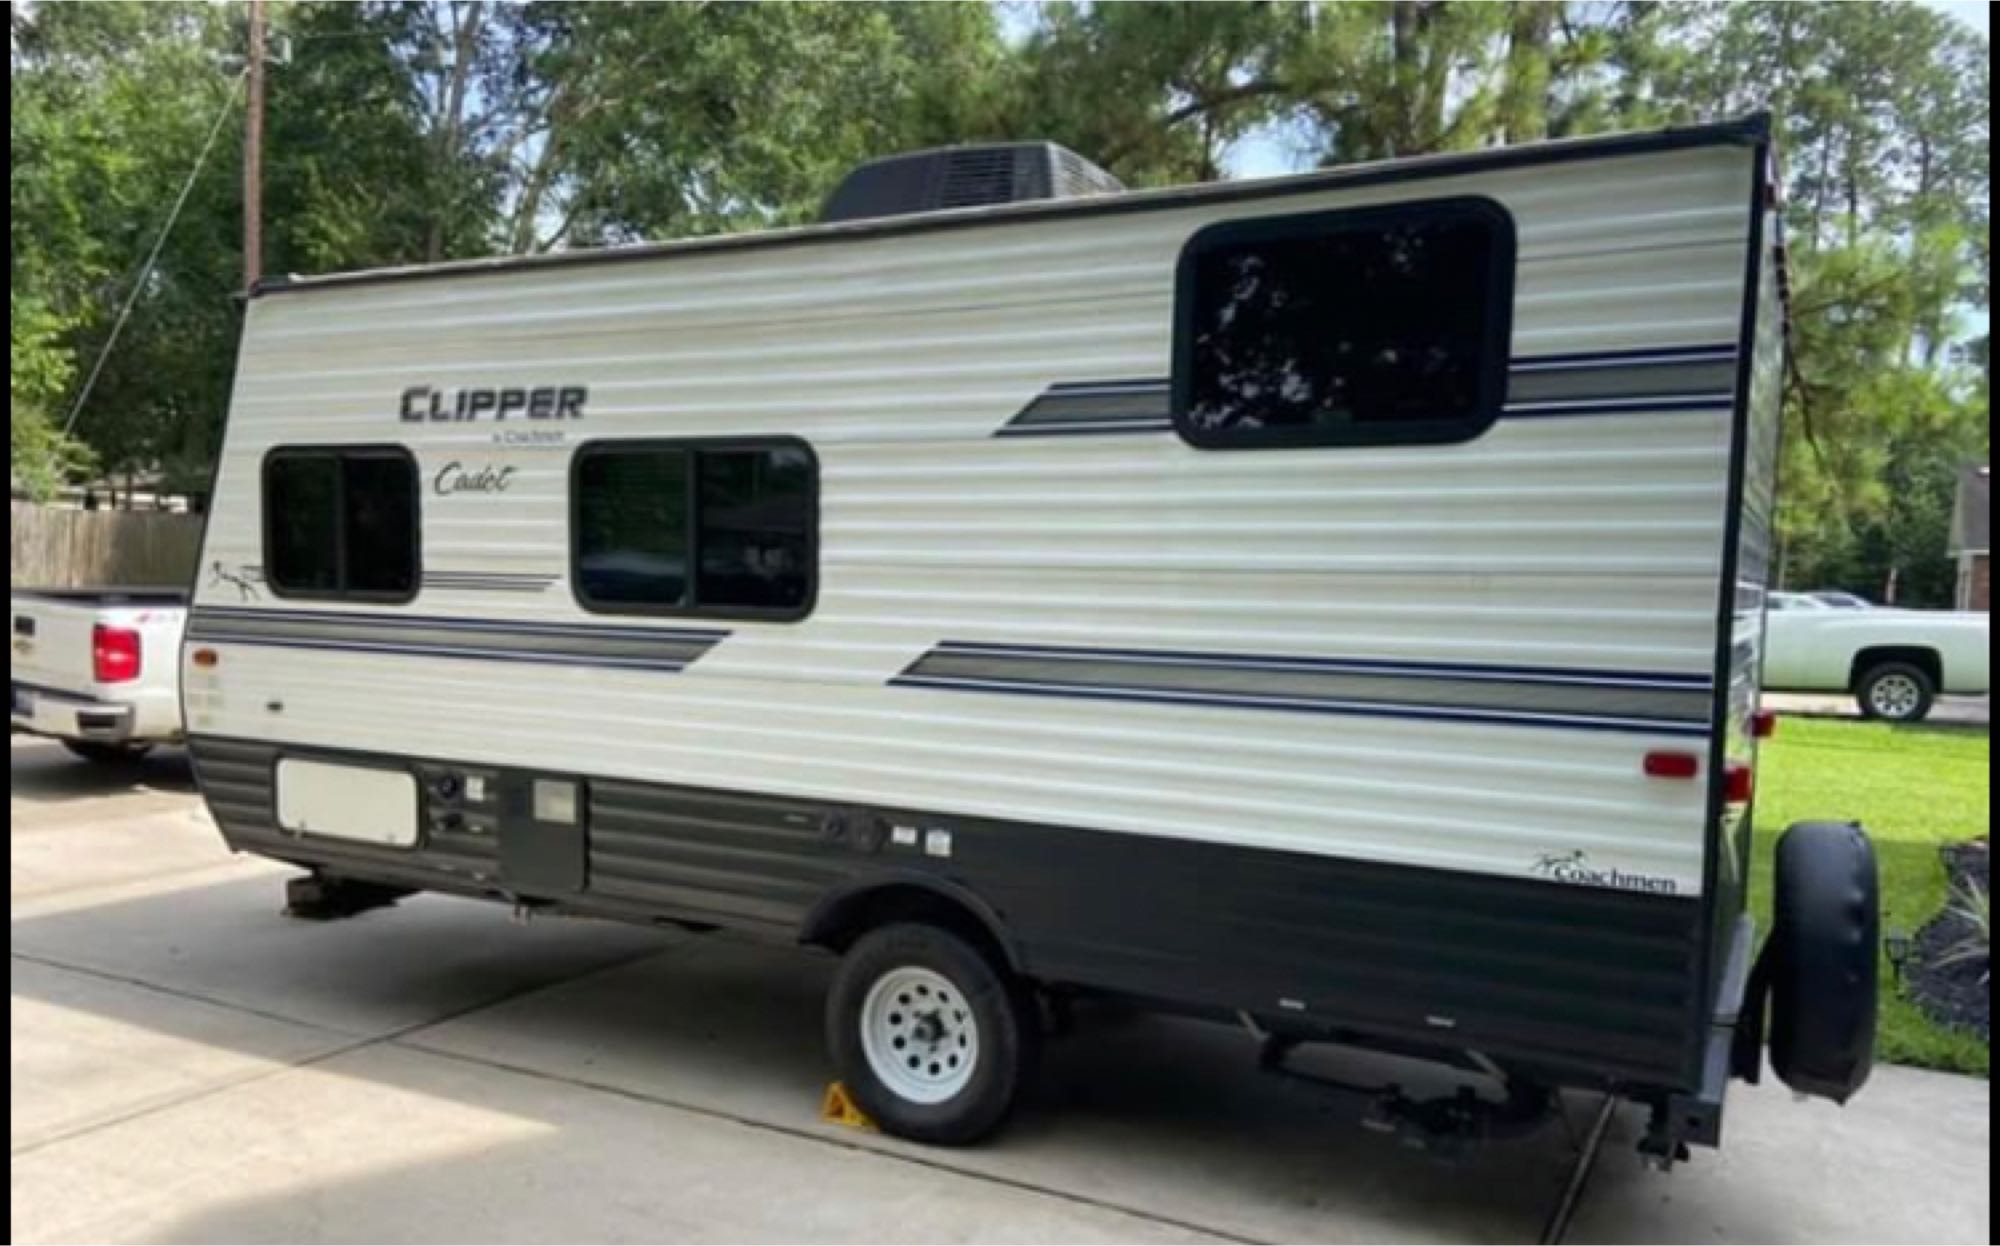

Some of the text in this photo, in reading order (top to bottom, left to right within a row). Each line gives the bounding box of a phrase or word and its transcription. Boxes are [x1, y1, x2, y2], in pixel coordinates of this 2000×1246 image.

[401, 384, 588, 422] CLIPPER
[434, 460, 519, 496] Cadet
[1554, 867, 1677, 894] Coachmen
